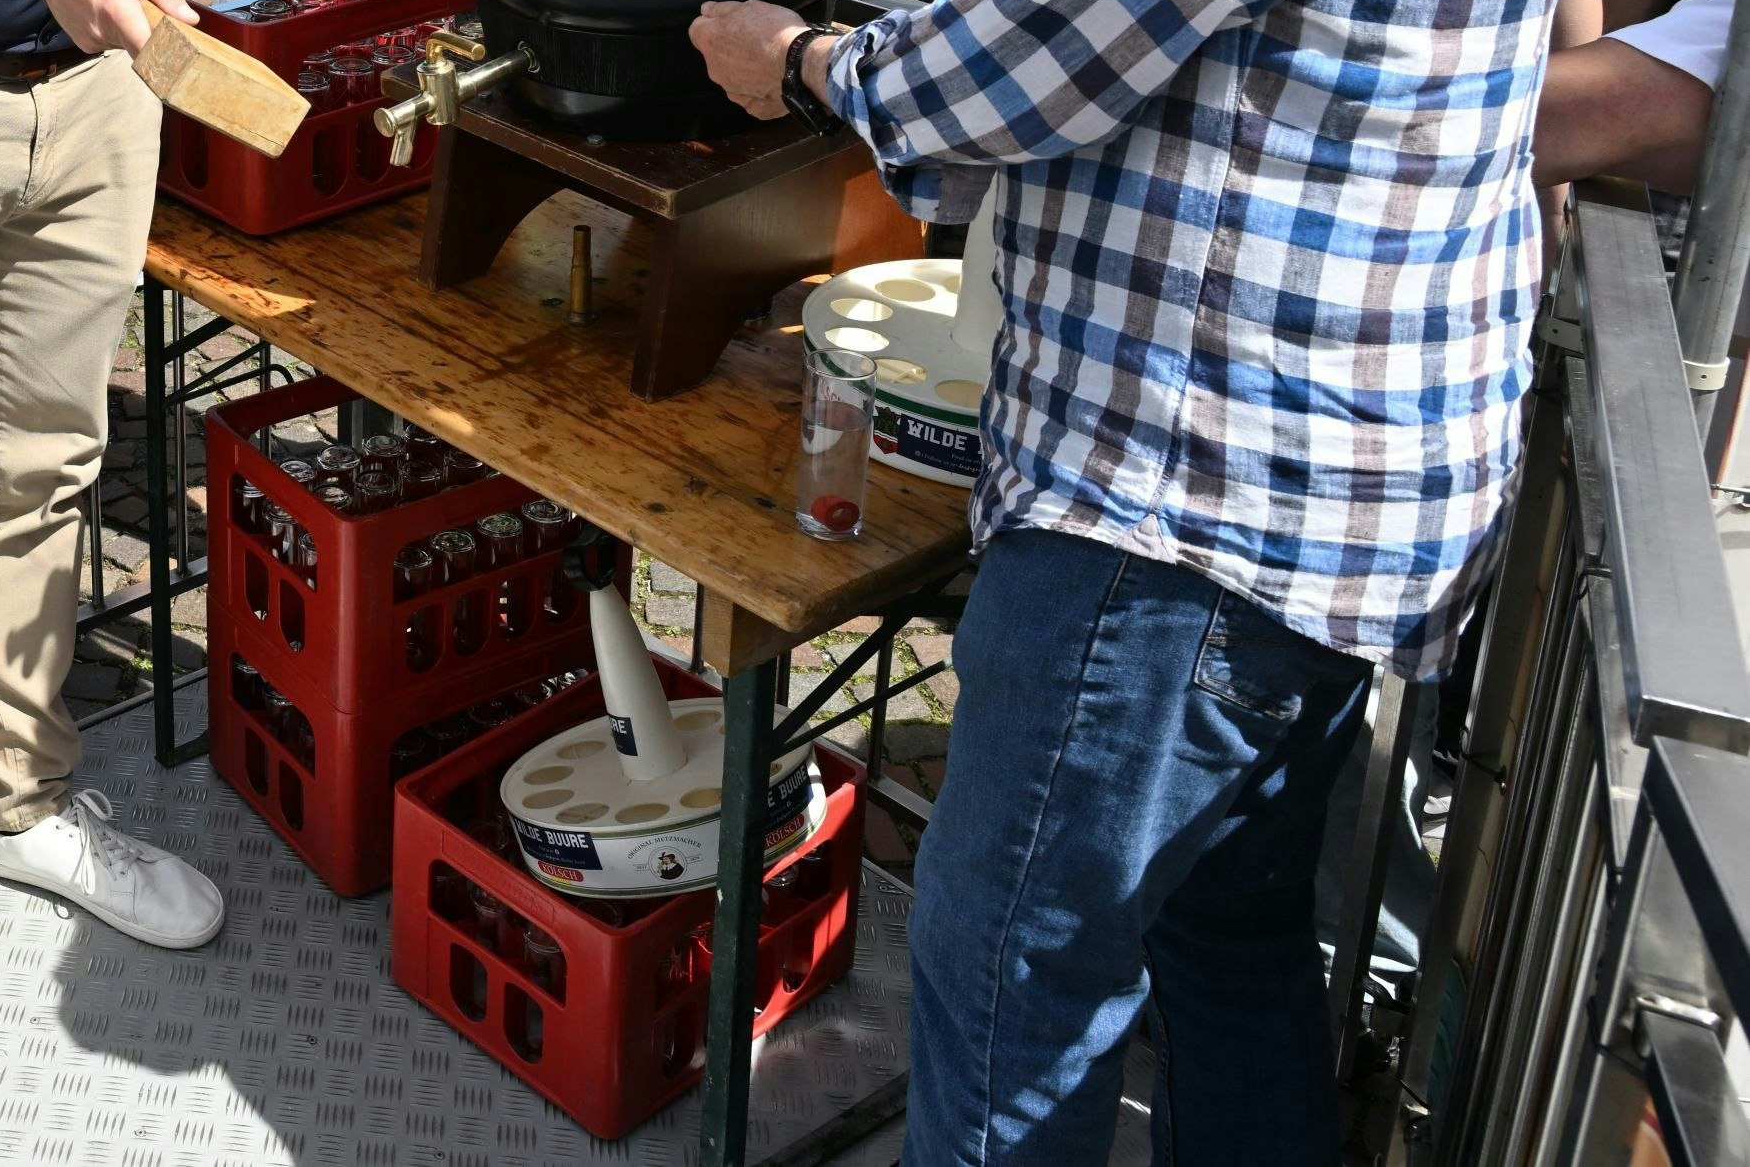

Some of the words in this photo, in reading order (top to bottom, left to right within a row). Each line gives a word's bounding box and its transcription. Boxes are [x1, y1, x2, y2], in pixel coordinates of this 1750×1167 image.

[906, 418, 969, 452] WILDE
[778, 764, 808, 800] BUURE
[514, 817, 543, 843] WILDE
[545, 830, 589, 849] BUURE
